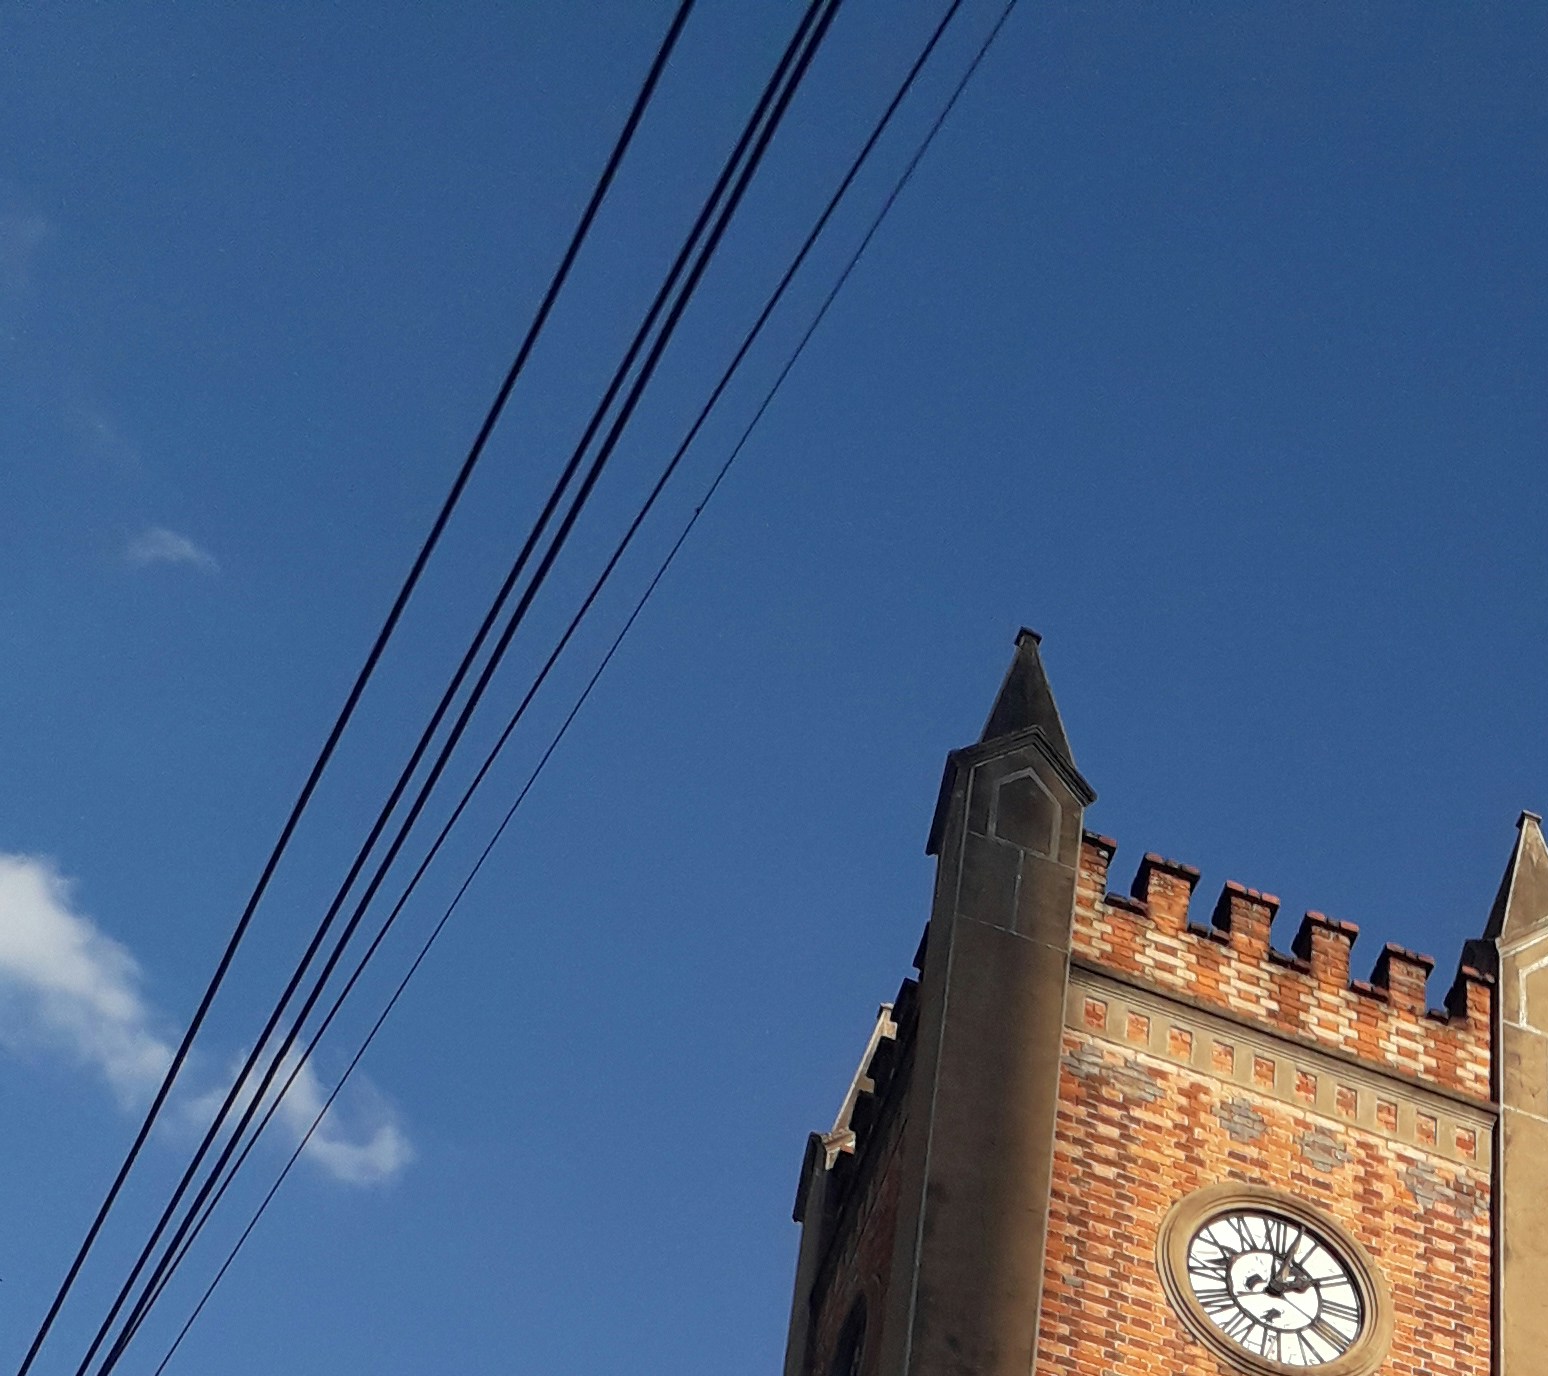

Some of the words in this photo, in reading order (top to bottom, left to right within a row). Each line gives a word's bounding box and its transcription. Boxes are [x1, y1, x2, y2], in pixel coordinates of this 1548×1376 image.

[1262, 1217, 1287, 1254] XII
[1314, 1273, 1349, 1288] II
[1194, 1289, 1236, 1315] VIII
[1321, 1299, 1359, 1323] III
[1218, 1310, 1255, 1344] VII
[1296, 1329, 1325, 1366] V
